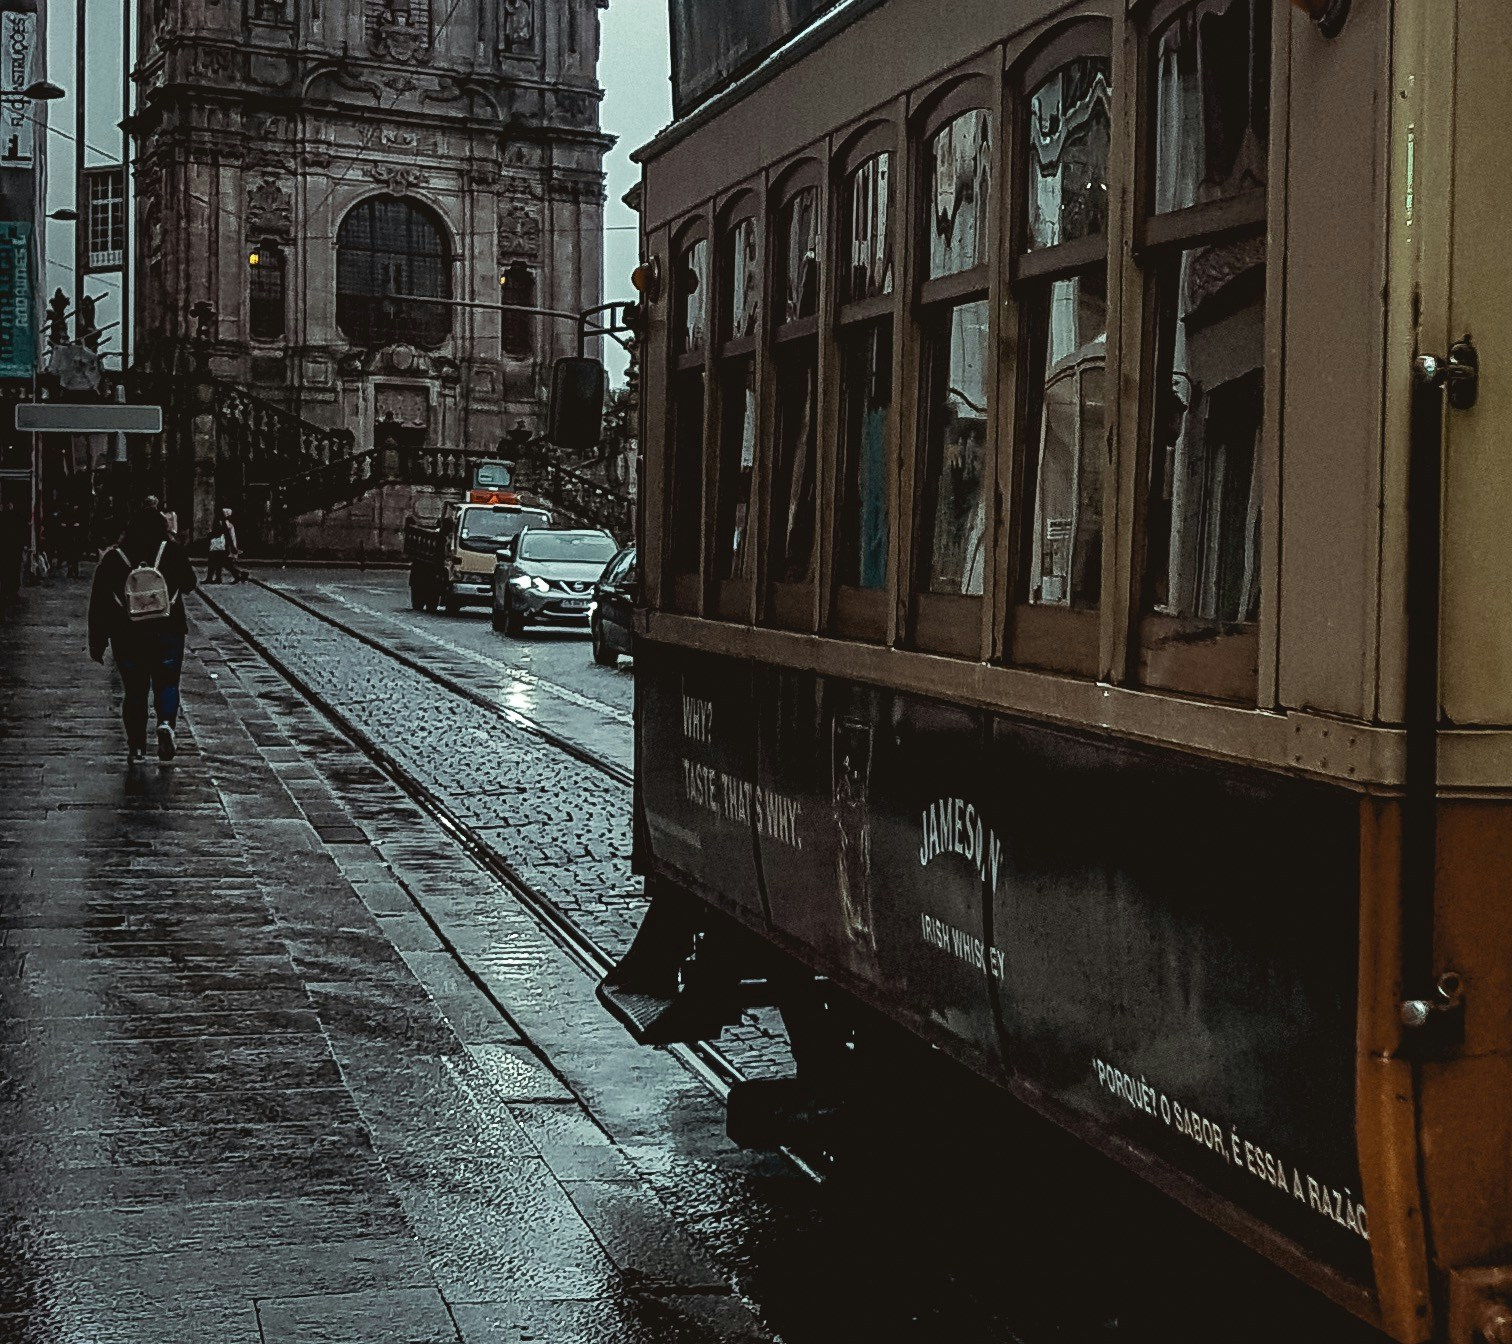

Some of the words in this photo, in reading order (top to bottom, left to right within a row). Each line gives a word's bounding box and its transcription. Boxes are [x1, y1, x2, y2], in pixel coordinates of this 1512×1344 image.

[683, 694, 713, 744] WHY?
[920, 797, 1002, 895] JAMESON
[921, 913, 950, 953] IRISH
[951, 926, 1005, 980] WHISKEY
[1160, 1093, 1171, 1125] O
[1231, 1124, 1243, 1167] É
[1244, 1140, 1289, 1193] ESSA
[1293, 1167, 1306, 1203] A
